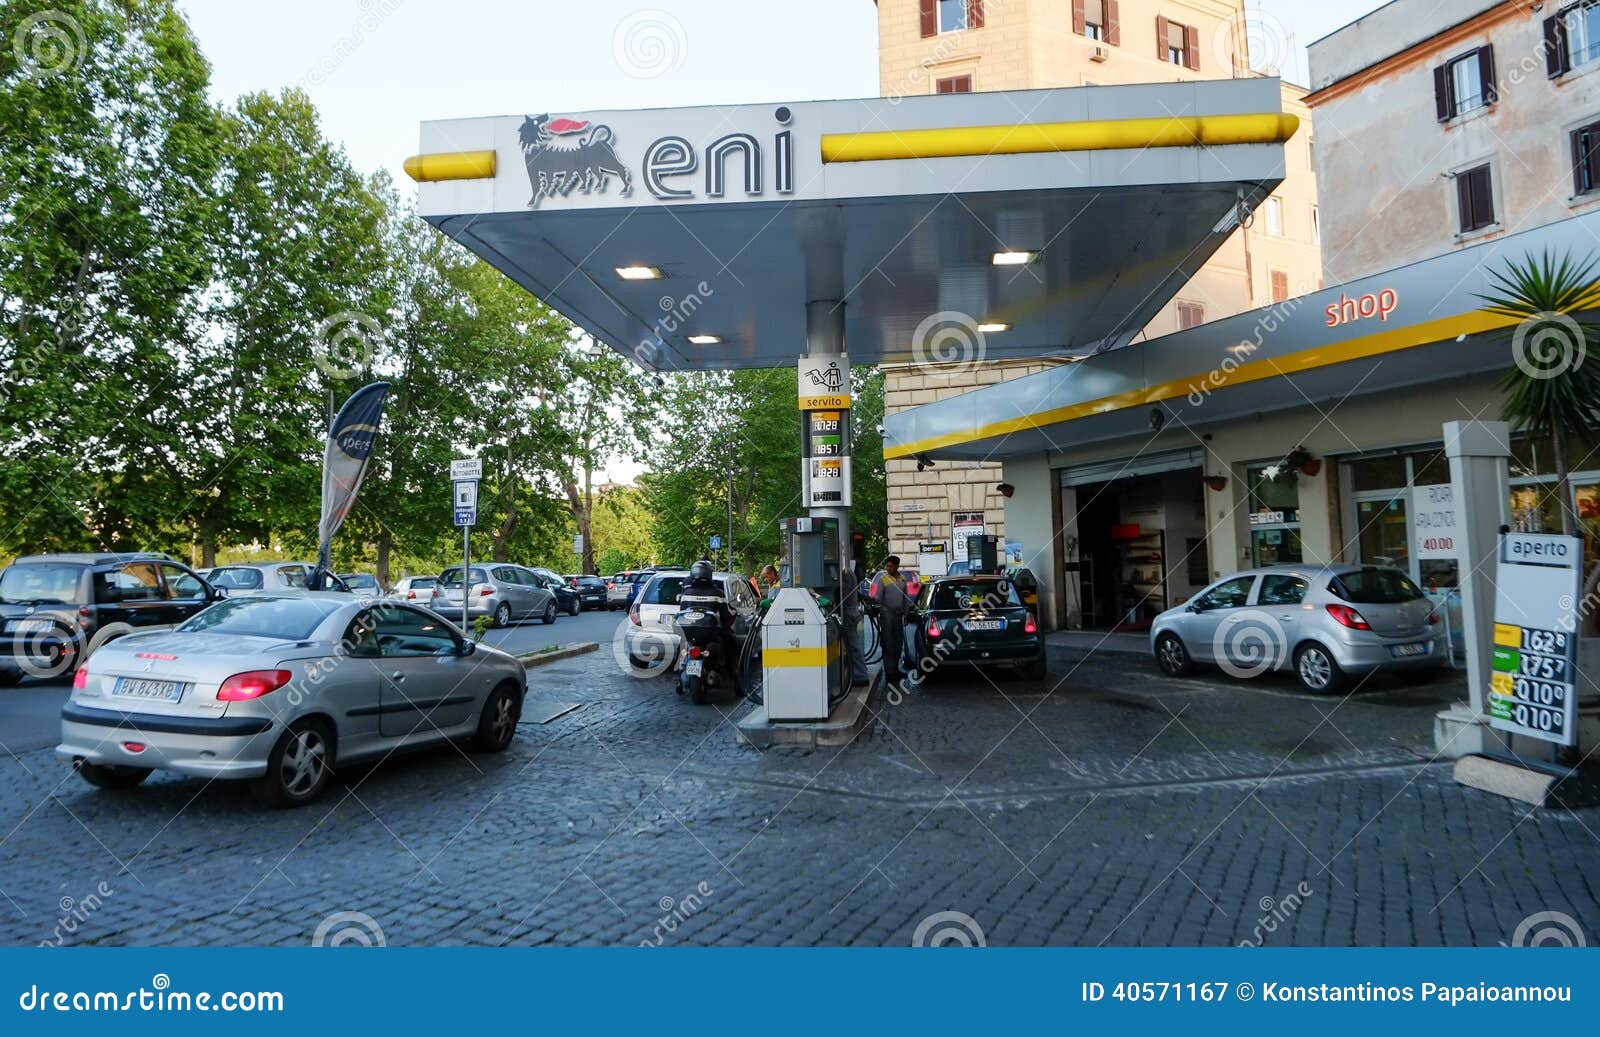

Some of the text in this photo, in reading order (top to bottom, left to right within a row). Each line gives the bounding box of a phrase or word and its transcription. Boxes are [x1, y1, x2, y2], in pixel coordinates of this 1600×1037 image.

[642, 106, 796, 200] eni
[1325, 289, 1398, 327] shop
[807, 397, 842, 407] servito
[1513, 540, 1567, 559] aperto
